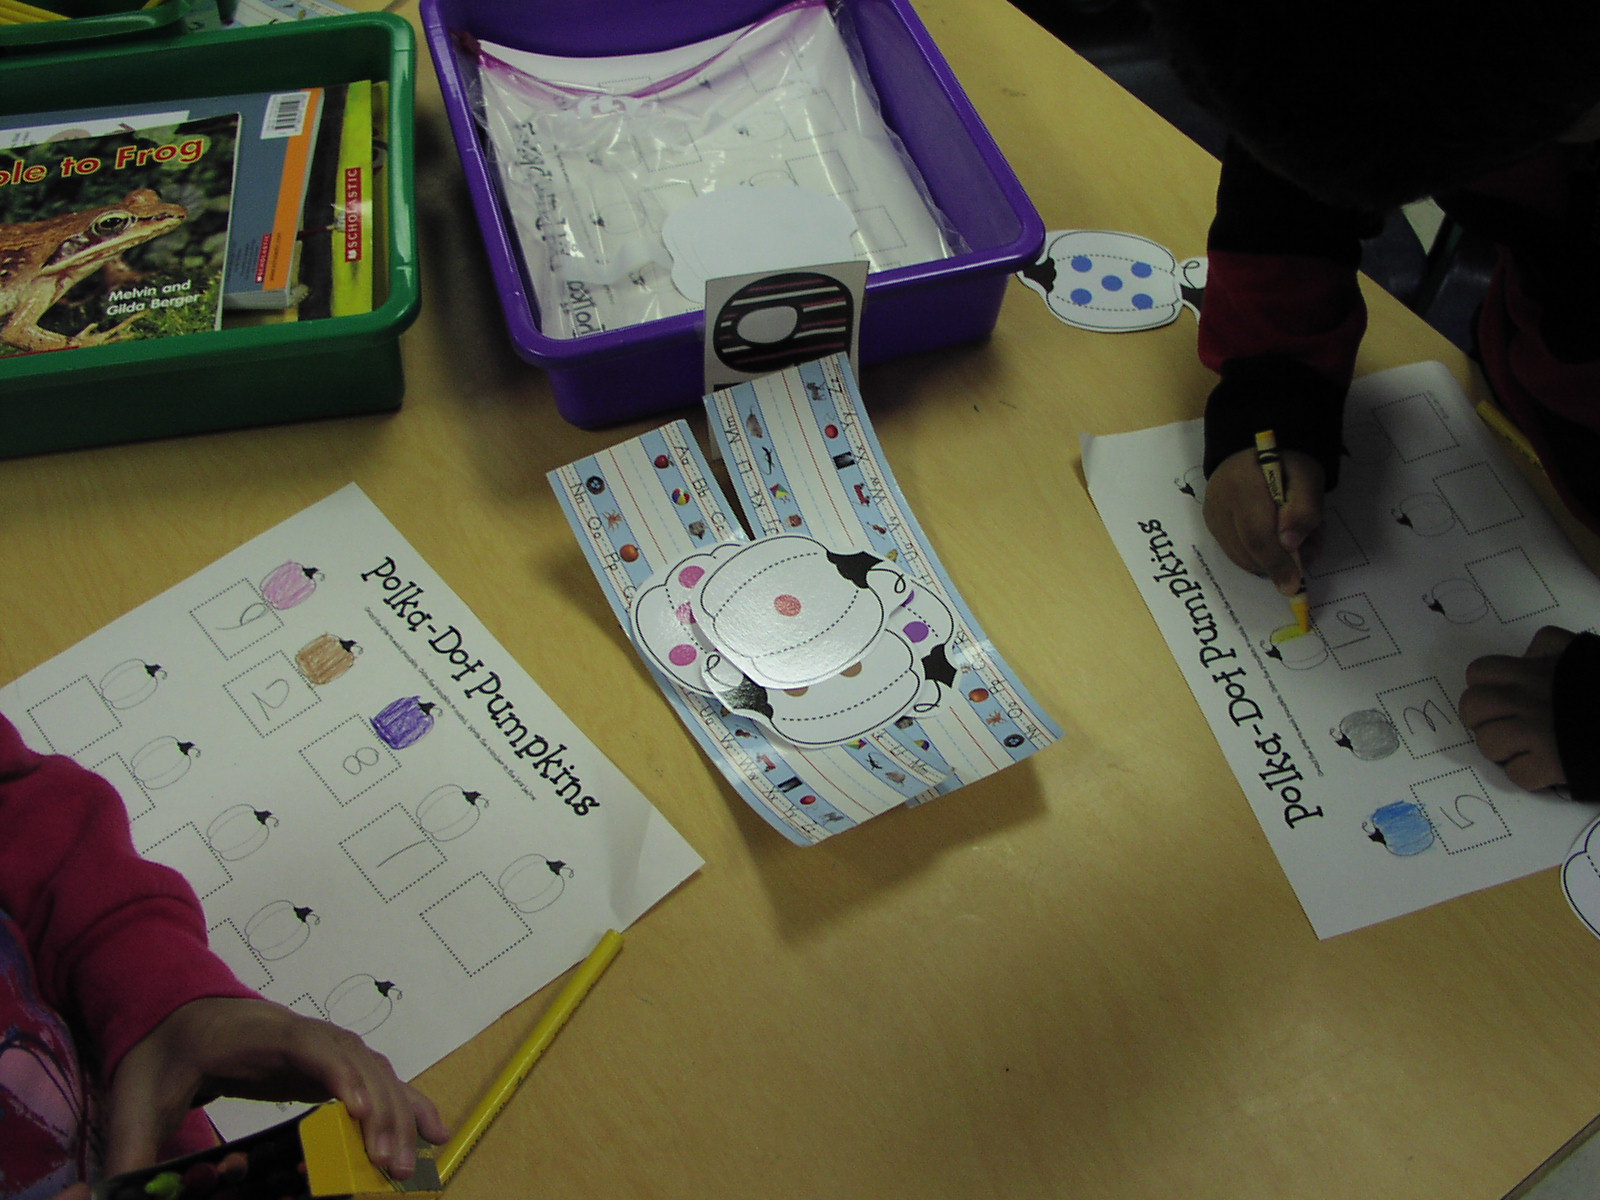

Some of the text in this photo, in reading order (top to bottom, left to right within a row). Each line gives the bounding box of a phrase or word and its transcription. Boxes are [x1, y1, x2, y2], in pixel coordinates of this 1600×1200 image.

[61, 156, 101, 177] to
[115, 138, 203, 170] Frog
[347, 168, 358, 248] SCHOLASTIC
[106, 293, 200, 316] Gilda Berger
[108, 278, 191, 302] Melvin and
[215, 602, 271, 630] 9
[361, 556, 600, 816] Polka-Dot Pumpkins
[1137, 519, 1324, 829] Polka-Dot Pumpkins
[252, 678, 290, 721] 2
[1403, 699, 1452, 735] 3
[343, 747, 380, 775] 8
[1439, 794, 1497, 830] 5
